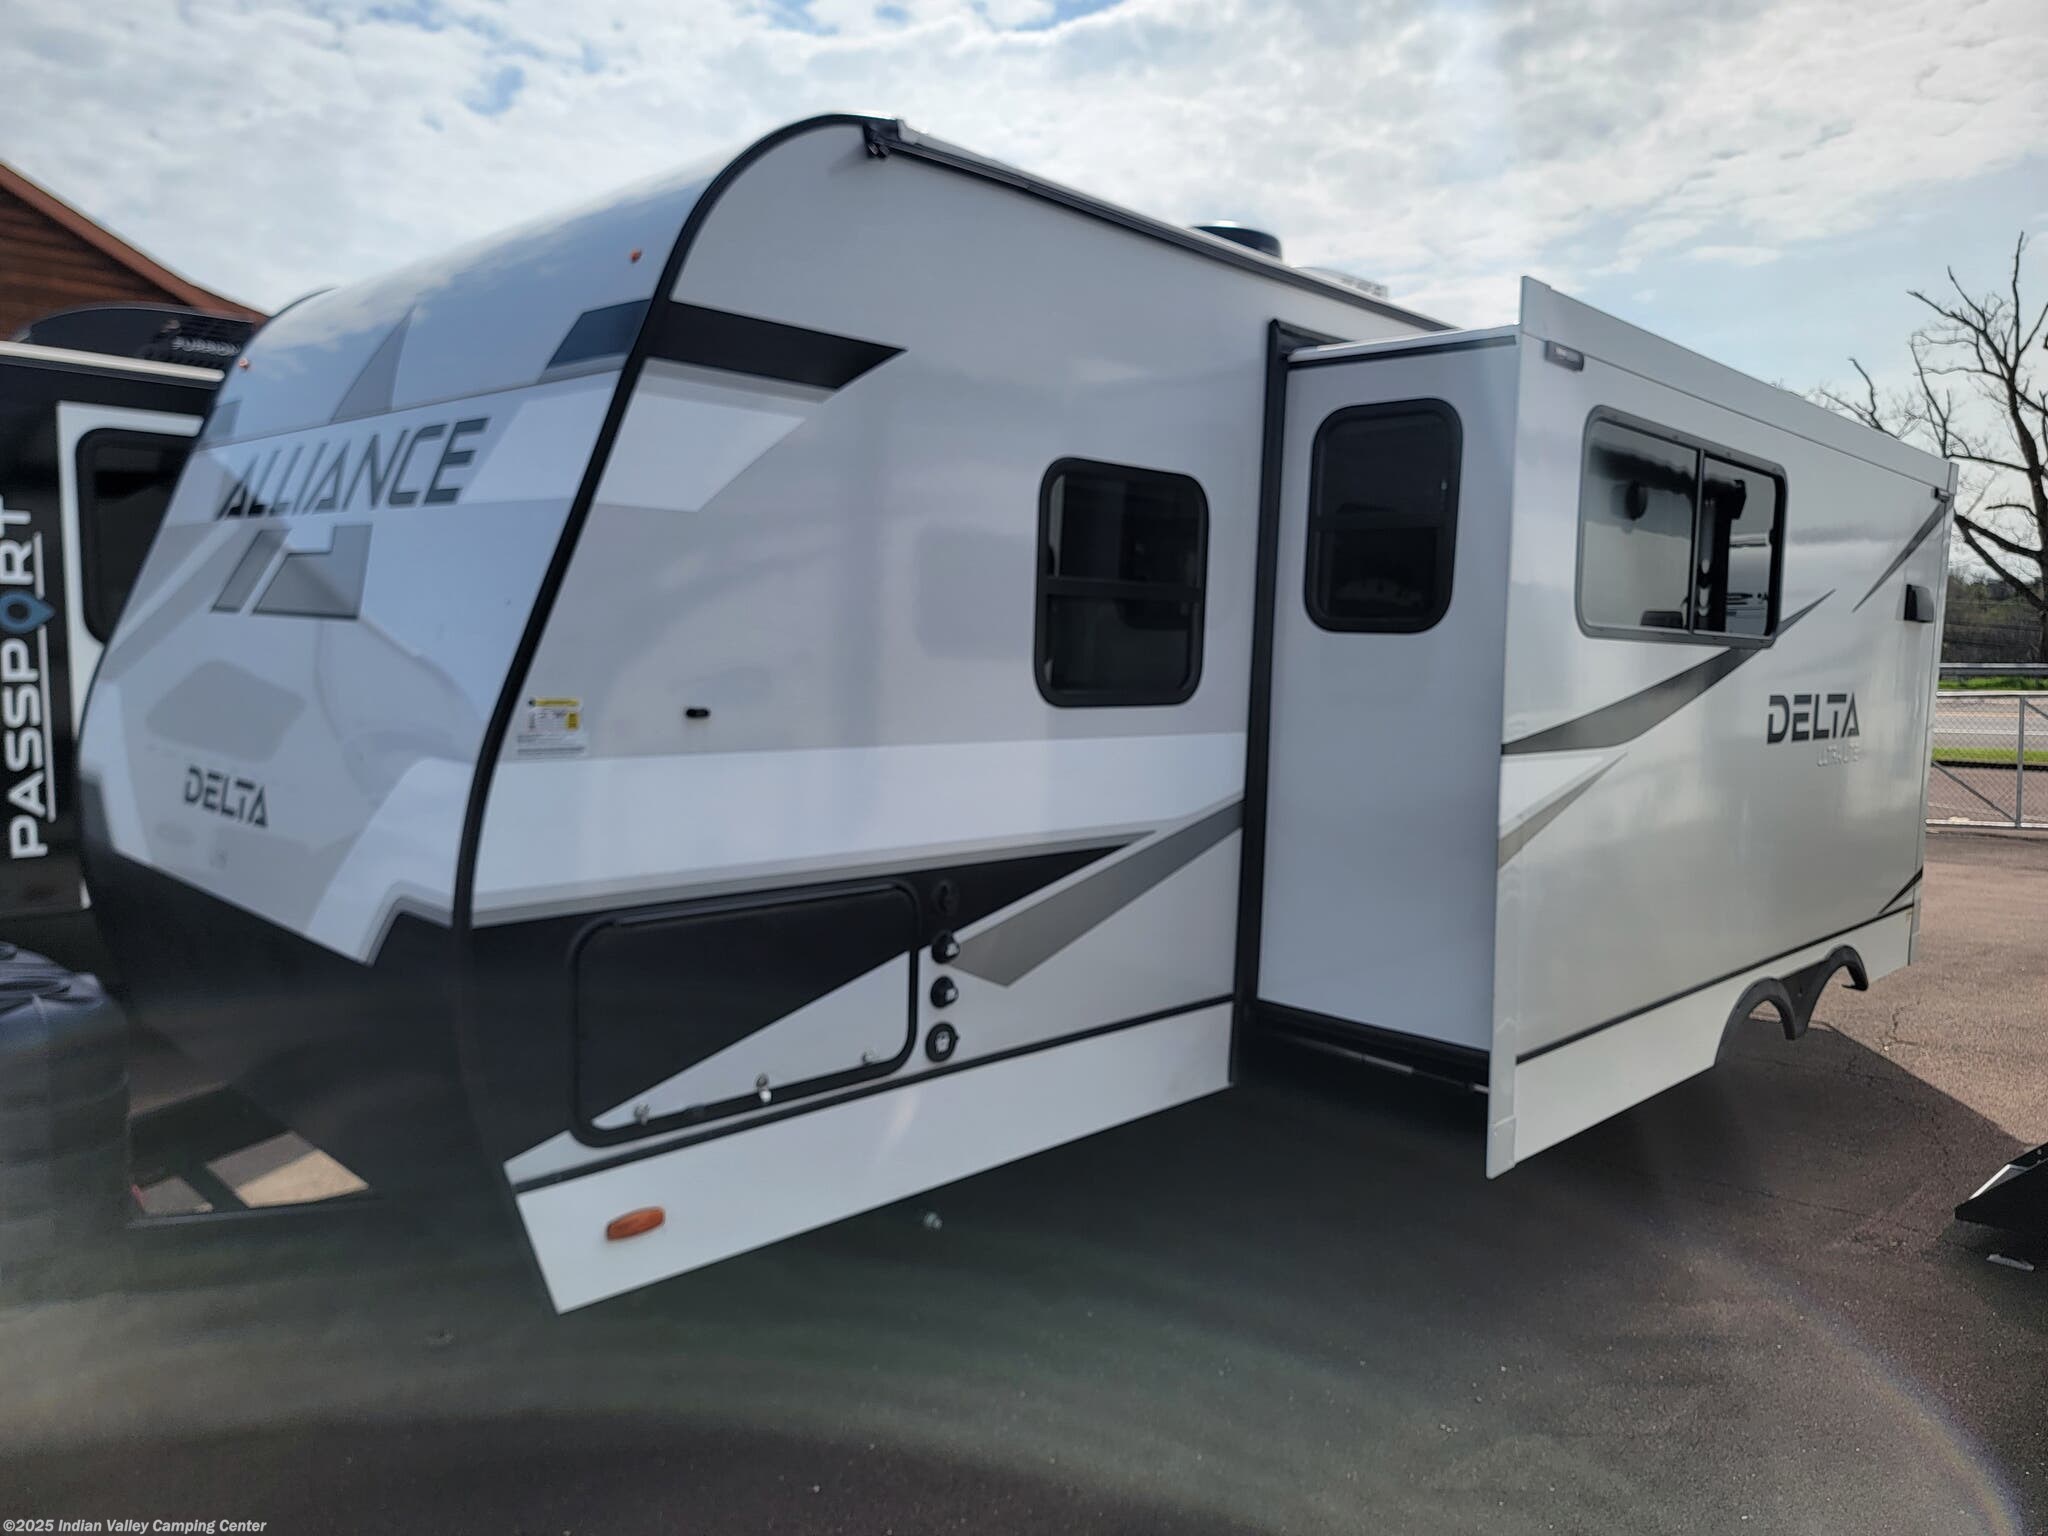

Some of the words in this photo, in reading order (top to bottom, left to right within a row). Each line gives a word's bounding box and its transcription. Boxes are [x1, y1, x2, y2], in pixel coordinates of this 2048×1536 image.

[215, 417, 491, 521] ALLIANCE
[0, 493, 56, 859] PASSPORT
[1767, 692, 1860, 744] DELTA
[184, 767, 268, 826] DELTA
